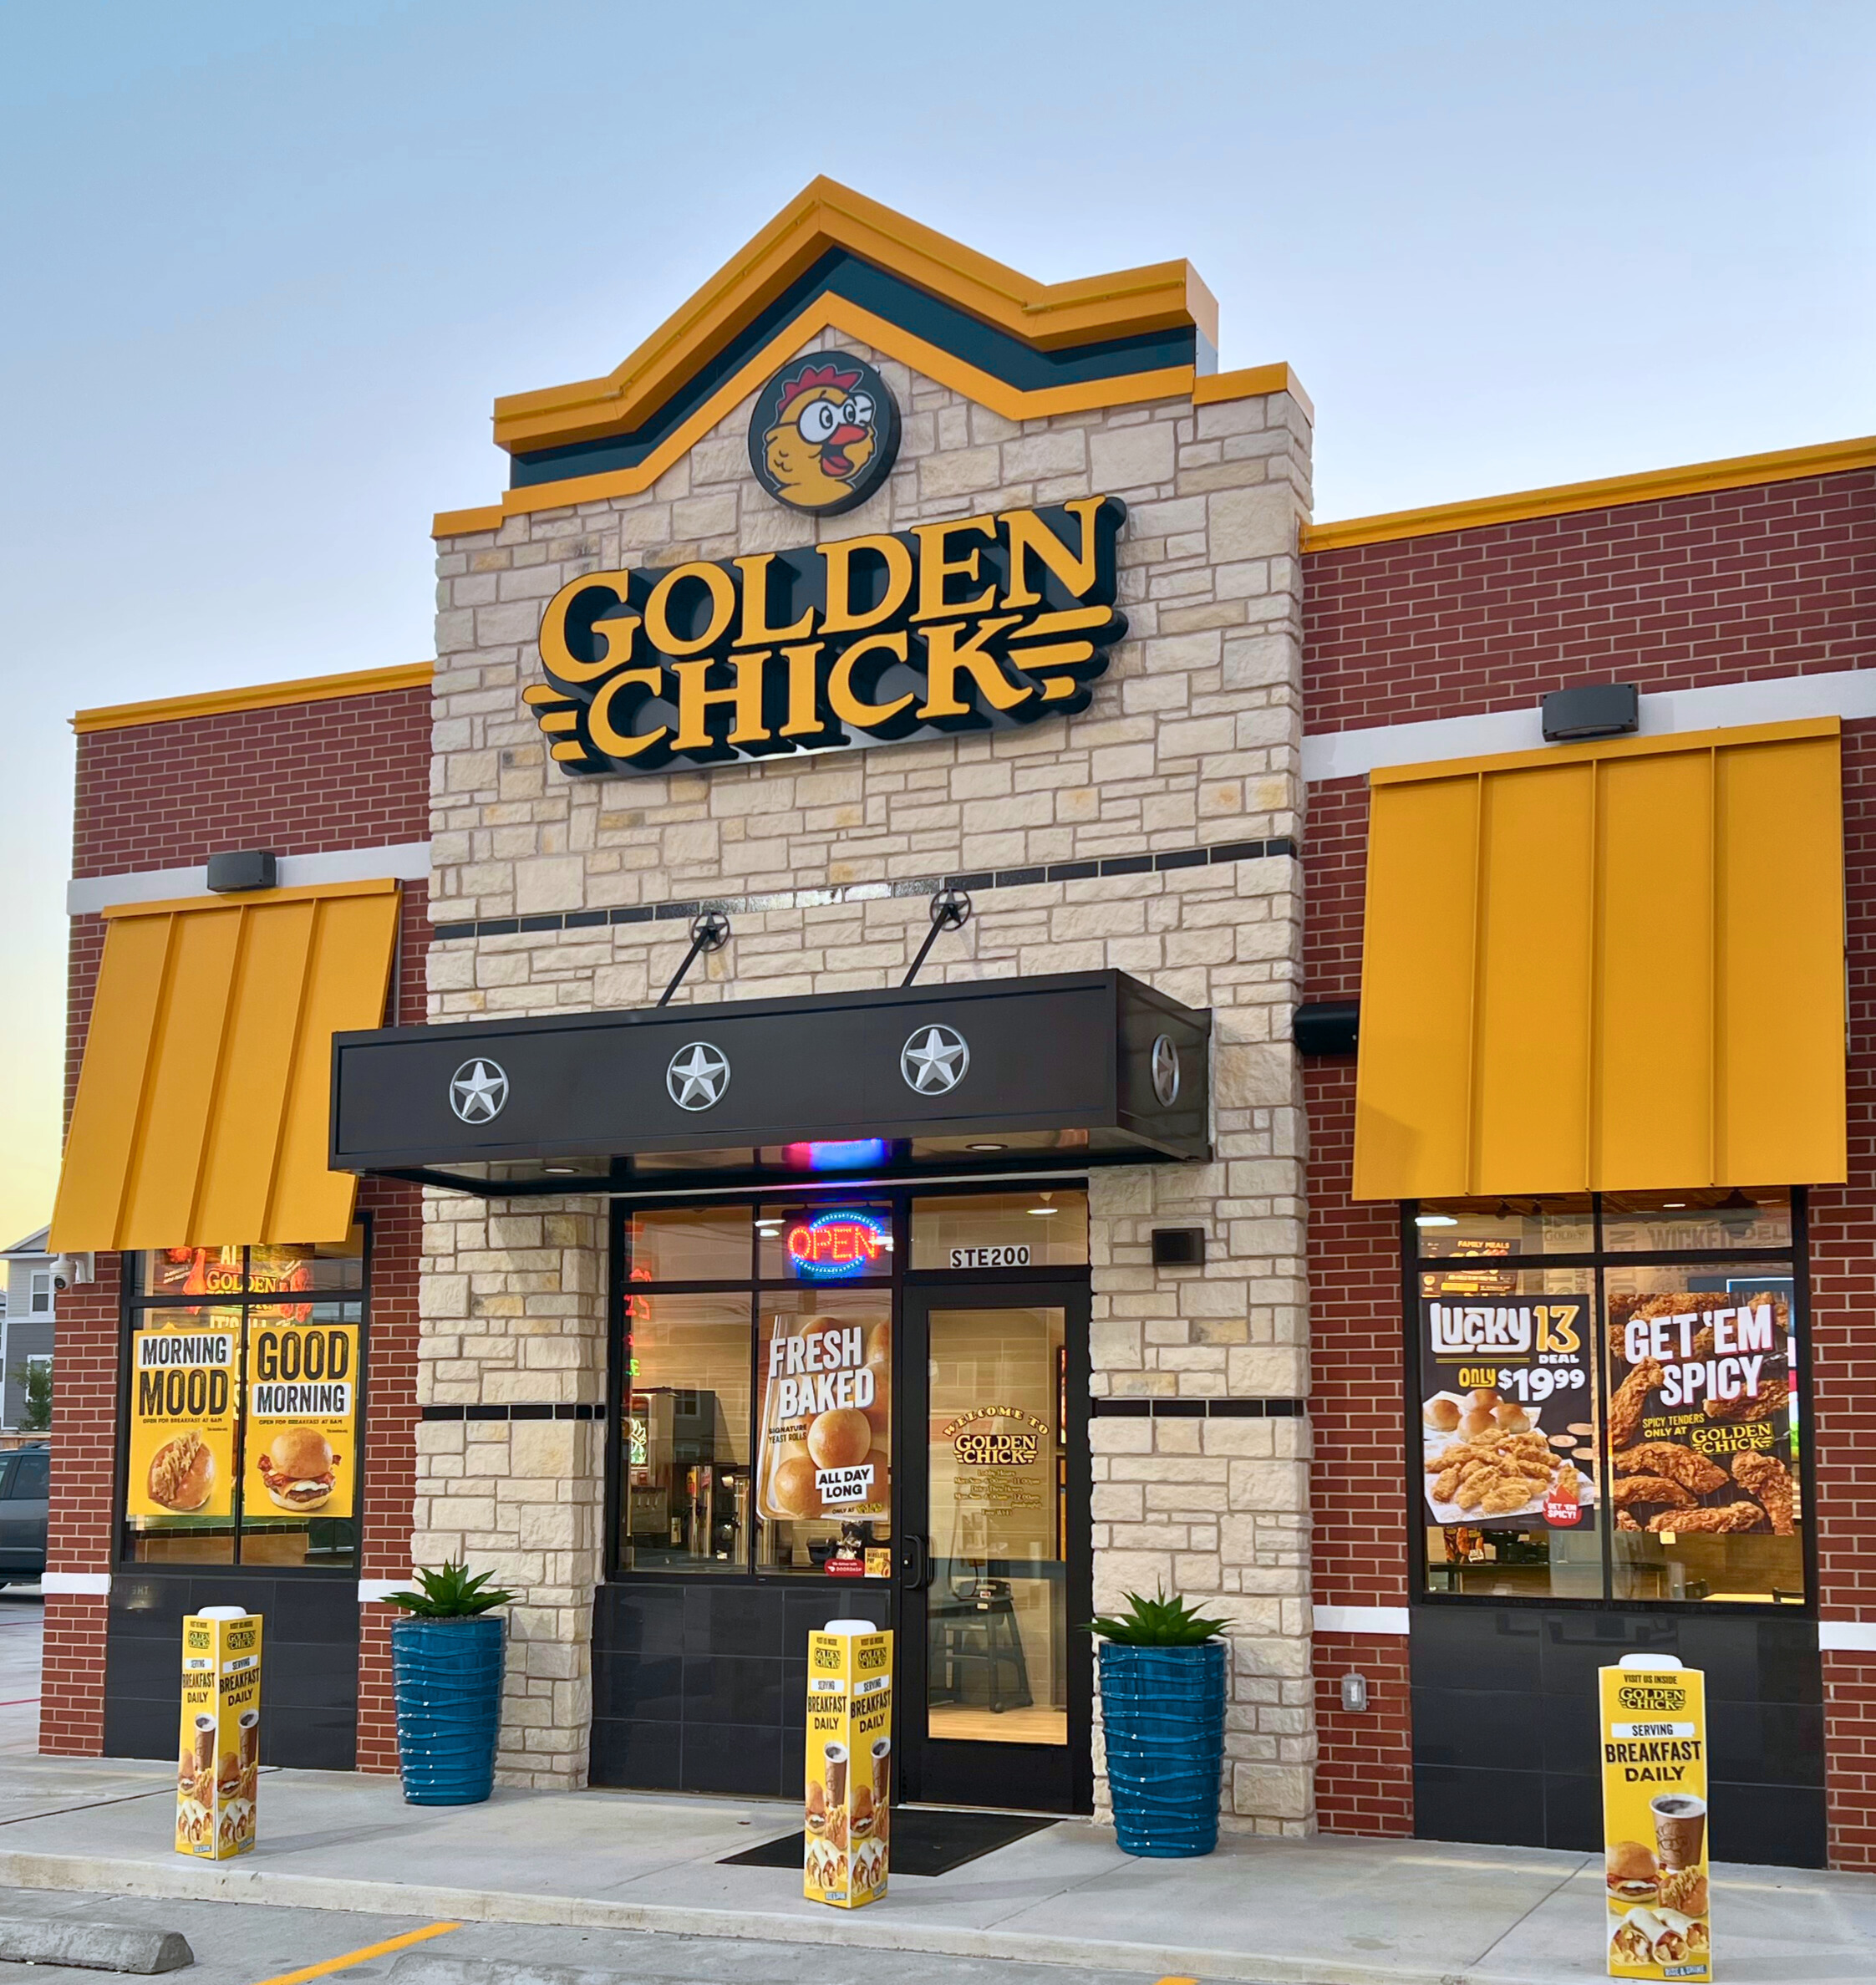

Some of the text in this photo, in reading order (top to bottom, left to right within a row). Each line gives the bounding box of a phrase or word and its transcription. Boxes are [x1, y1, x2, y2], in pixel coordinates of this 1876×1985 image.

[539, 495, 1106, 683] GOLDEN
[587, 614, 1034, 758] CHICK
[789, 1225, 880, 1260] OPEN
[1430, 1302, 1580, 1353] LUCKY 13
[1624, 1312, 1698, 1364] GET
[143, 1337, 226, 1365] MORNING
[257, 1331, 348, 1381] GOOD
[770, 1326, 862, 1378] FRESH
[1538, 1354, 1579, 1364] DEAL
[1458, 1367, 1496, 1387] ONLY
[1660, 1355, 1764, 1407] SPICY
[139, 1369, 228, 1416] MOOD
[257, 1385, 344, 1412] MORNING
[780, 1368, 875, 1419] BAKED
[769, 1424, 807, 1434] SIGNATURE
[943, 1406, 1050, 1437] WELCOME TO
[1643, 1413, 1705, 1428] SPICY TENDERS
[769, 1432, 807, 1444] YEAST ROLLS
[1644, 1426, 1687, 1438] ONLY AT
[1691, 1423, 1772, 1444] GOLDEN
[955, 1434, 1037, 1452] GOLDEN
[1701, 1438, 1763, 1453] CHICK
[963, 1449, 1027, 1463] CHICK
[819, 1468, 870, 1484] ALL DAY
[826, 1484, 862, 1498] LONG
[1547, 1510, 1577, 1519] SPICY!
[232, 1657, 250, 1670] SERVING
[183, 1672, 215, 1688] BREAKFAST
[220, 1668, 260, 1693] BREAKFAST
[818, 1680, 835, 1690] SERVING
[863, 1678, 882, 1692] SERVING
[1624, 1674, 1677, 1684] VISIT US INSIDE
[187, 1692, 208, 1703] DAILY
[228, 1688, 253, 1706] DAILY
[1620, 1688, 1684, 1700] GOLDEN
[808, 1696, 846, 1713] BREAKFAST
[851, 1690, 891, 1718] BREAKFAST
[1627, 1698, 1677, 1710] CHICK
[814, 1718, 839, 1730] DAILY
[860, 1713, 885, 1733] DAILY
[1632, 1724, 1673, 1736] SERVING
[1605, 1741, 1701, 1763] BREAKFAST
[1624, 1766, 1685, 1782] DAILY
